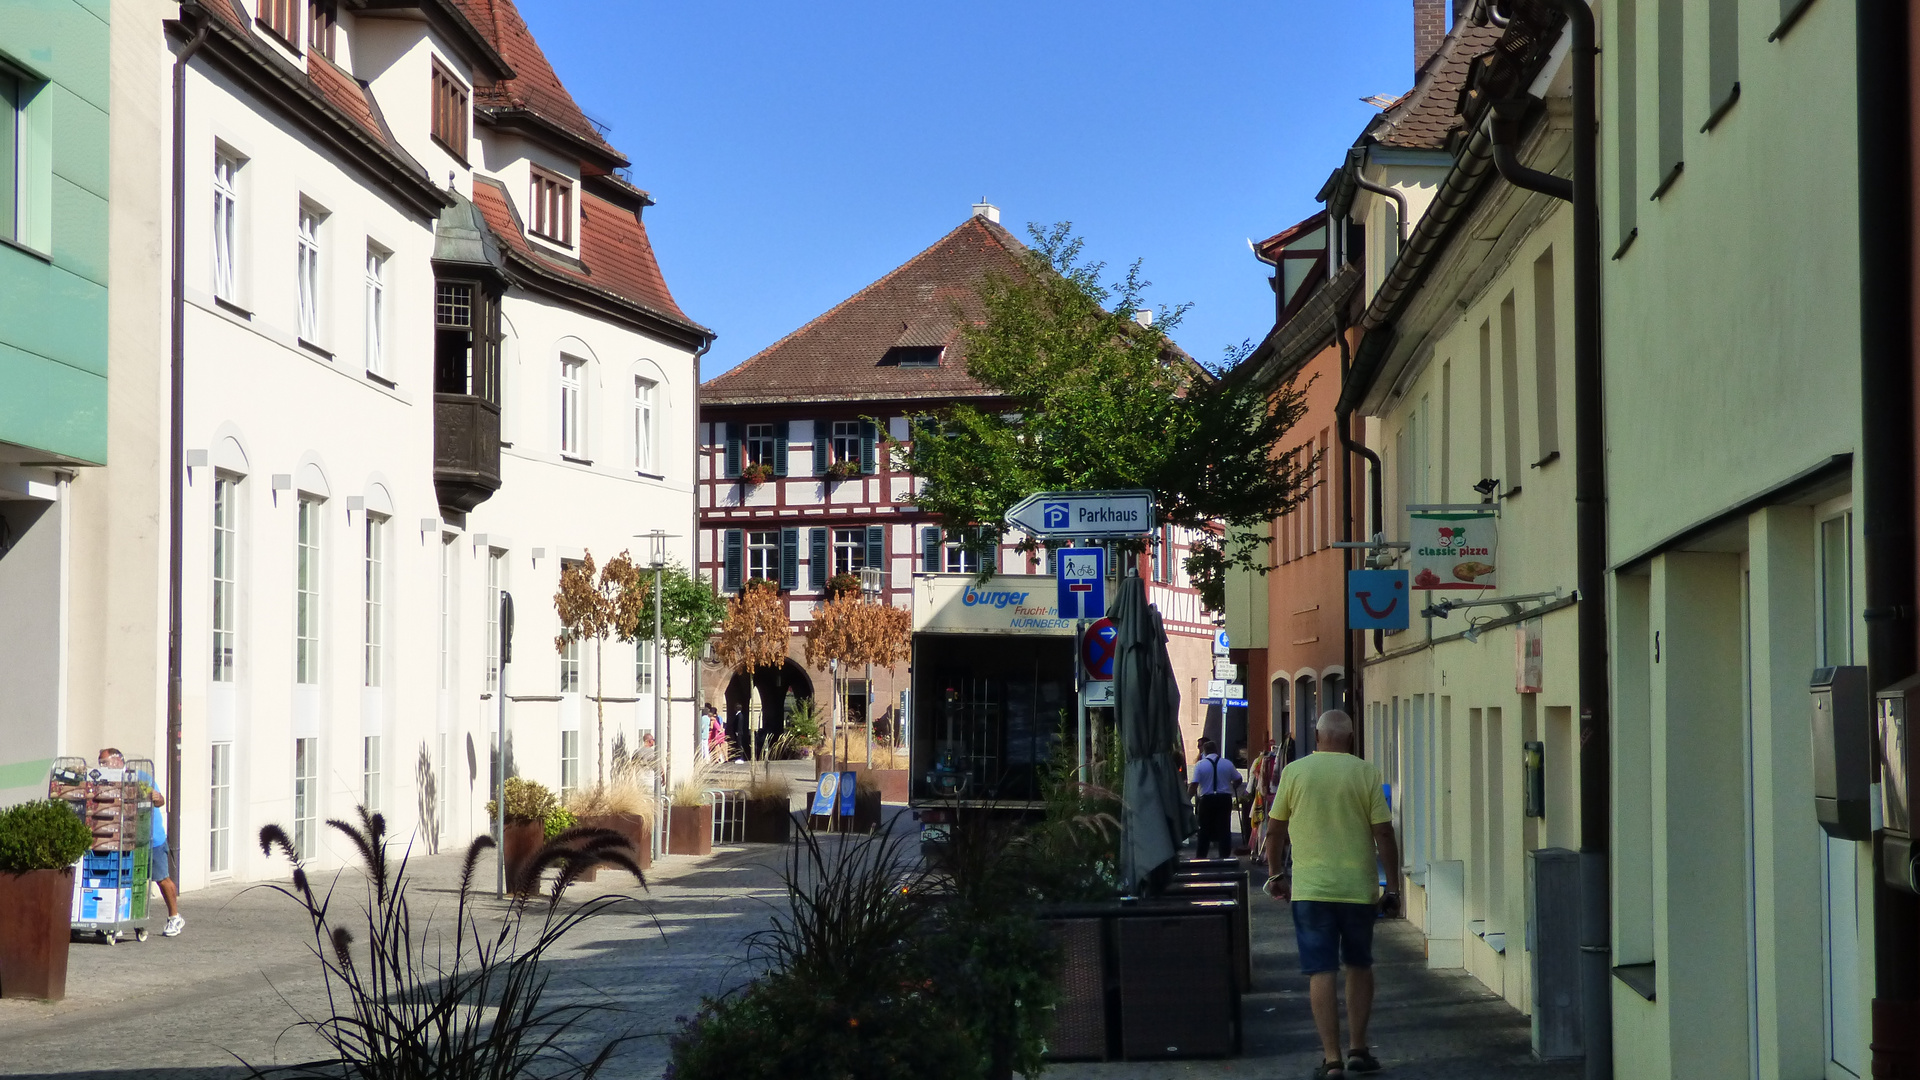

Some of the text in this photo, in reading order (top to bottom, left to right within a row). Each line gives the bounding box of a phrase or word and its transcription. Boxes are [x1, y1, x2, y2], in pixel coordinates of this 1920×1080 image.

[1079, 507, 1138, 522] Parkhaus
[1418, 545, 1489, 557] classic pizza
